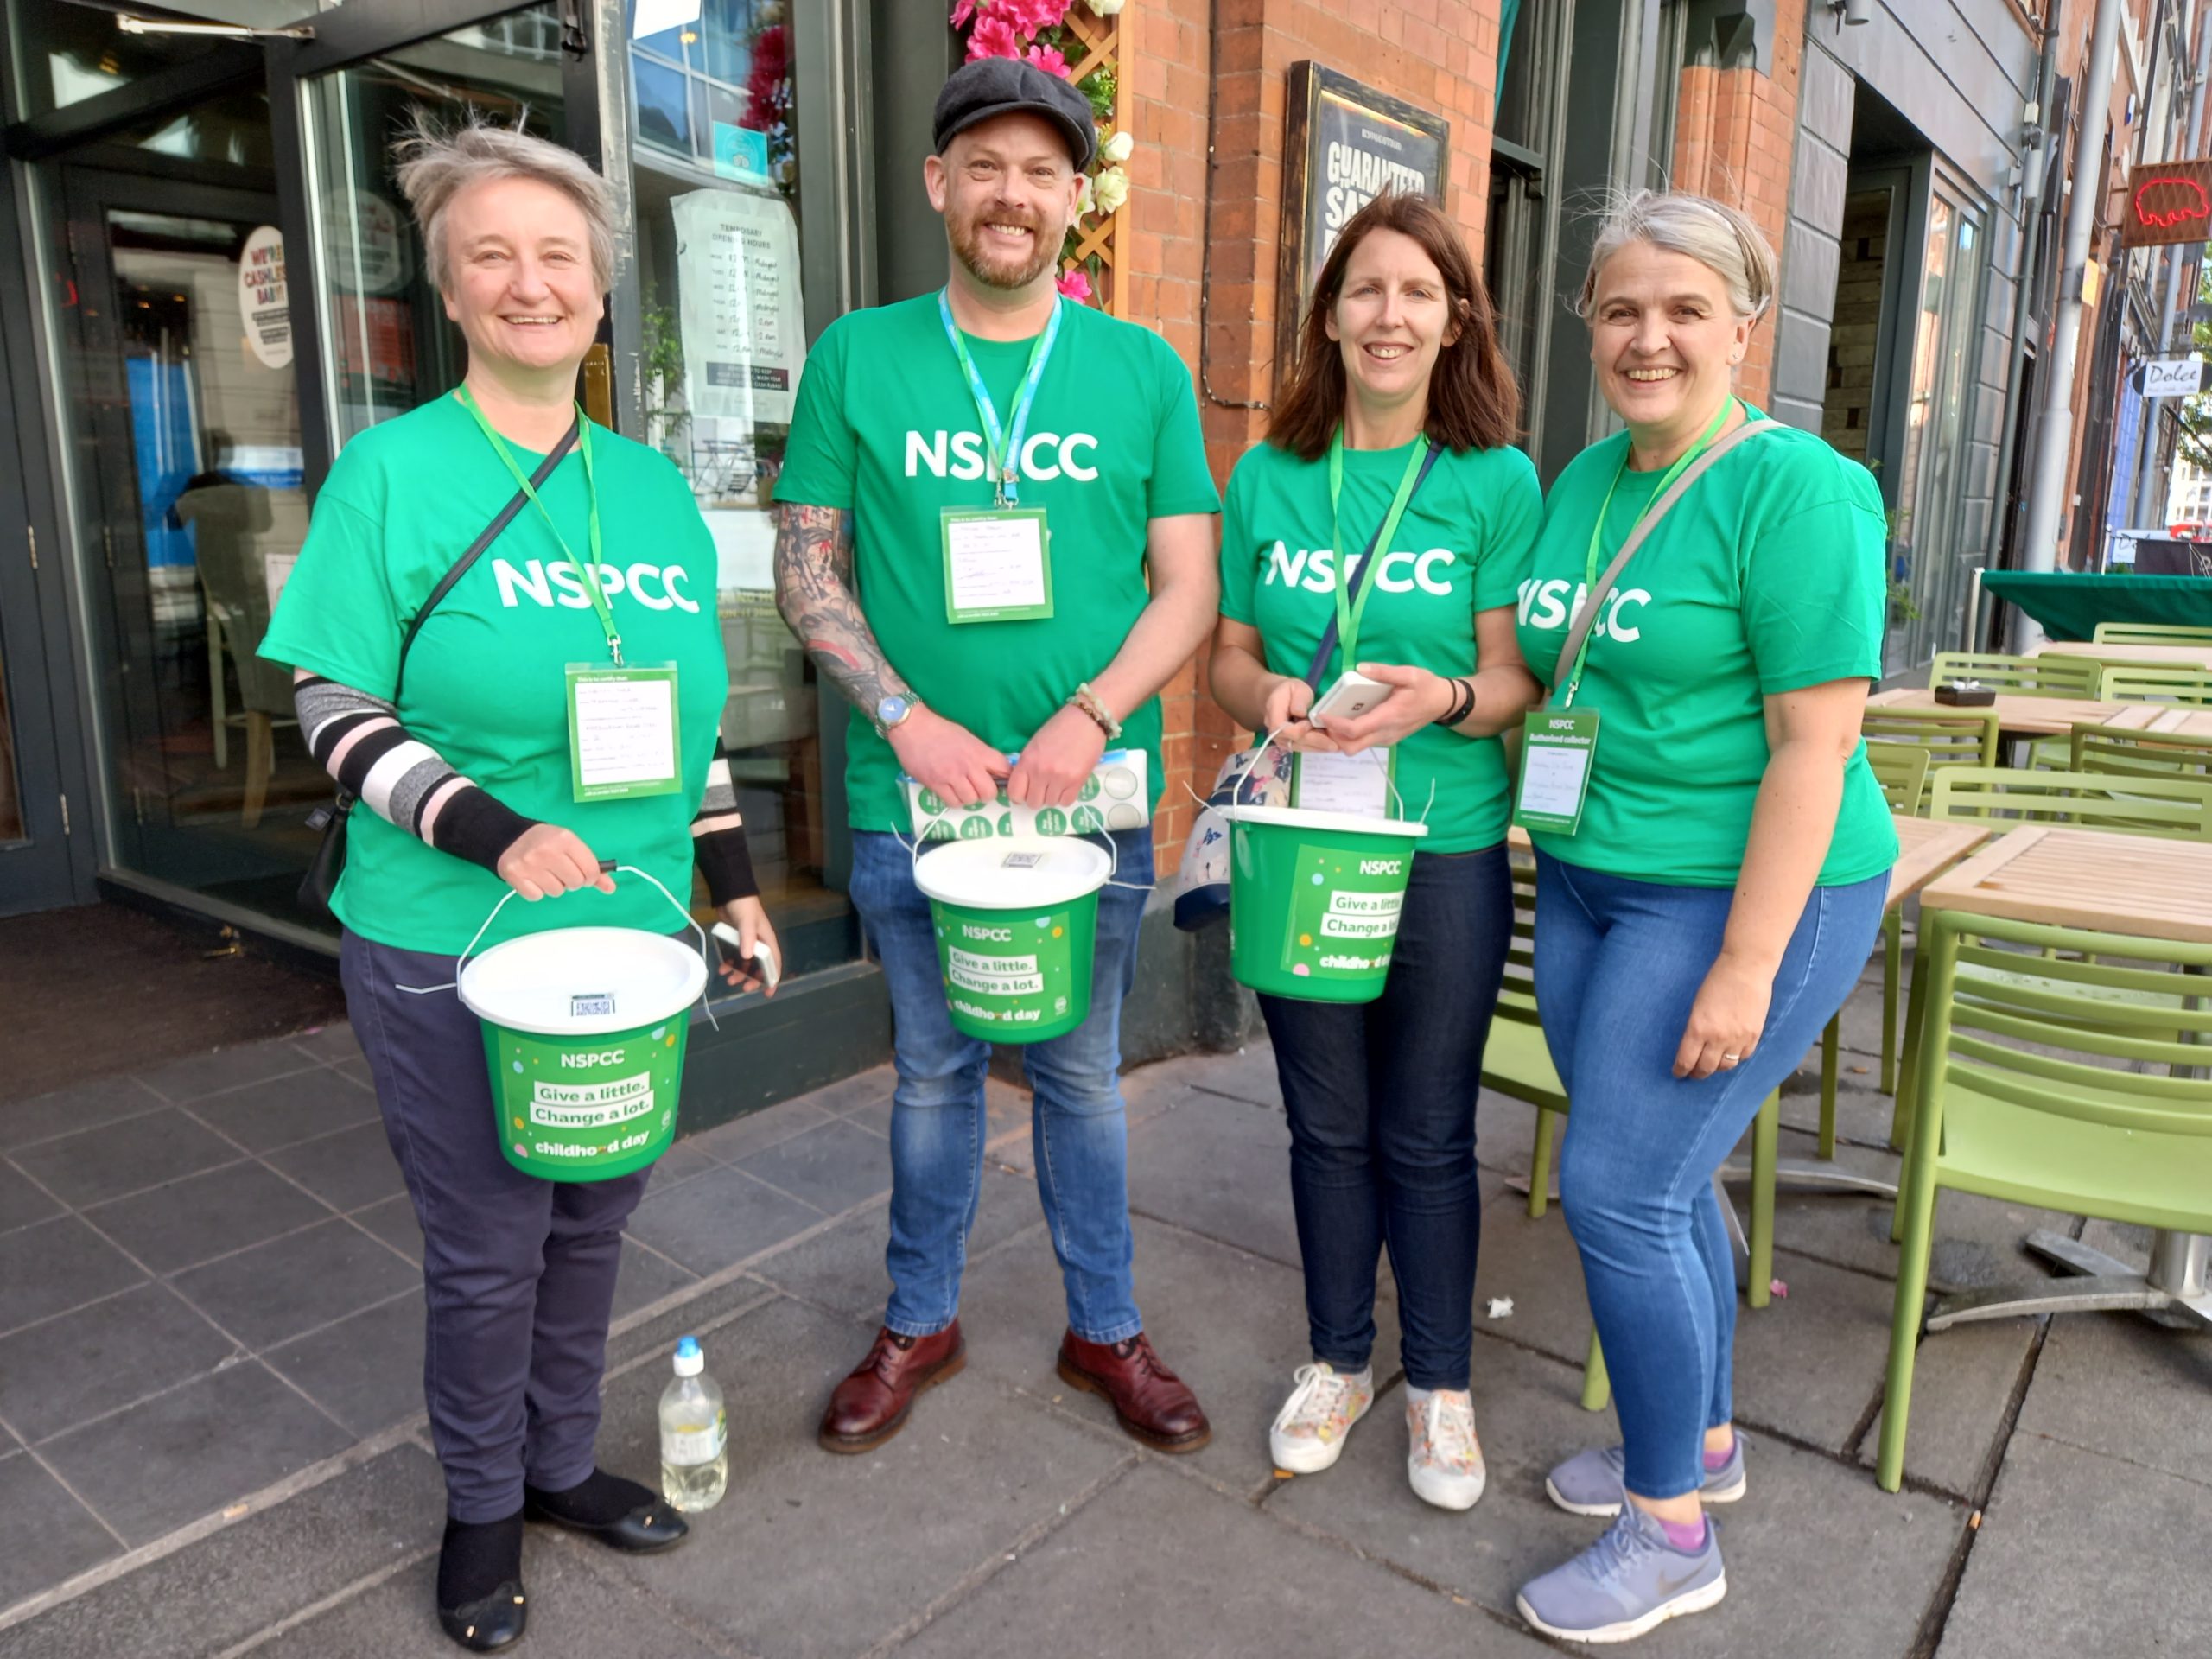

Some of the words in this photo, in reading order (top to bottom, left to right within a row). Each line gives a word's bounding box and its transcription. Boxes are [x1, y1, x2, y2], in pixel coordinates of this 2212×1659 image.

[1327, 141, 1426, 199] GUARANTEED
[747, 239, 771, 250] HOURS
[2150, 364, 2196, 384] Dolce
[491, 558, 700, 613] NSPCC
[1548, 719, 1575, 730] NSPCC
[1359, 859, 1402, 875] NSPCC
[1336, 897, 1368, 910] Give
[1370, 900, 1377, 910] a
[962, 924, 1012, 942] NSPCC
[1326, 918, 1379, 937] Change
[1382, 923, 1387, 931] a
[953, 952, 978, 969] Give
[982, 961, 989, 970] a
[994, 960, 1033, 972] little.
[952, 969, 999, 993] Change
[1001, 982, 1011, 991] a
[1014, 979, 1039, 991] lot.
[1014, 1008, 1041, 1022] day
[561, 1049, 626, 1069] NSPCC
[539, 1088, 580, 1103] Give
[584, 1091, 595, 1102] a
[600, 1080, 645, 1100] little.
[535, 1108, 605, 1127] Change
[608, 1109, 620, 1120] a
[623, 1100, 650, 1116] lot.
[621, 1130, 650, 1150] day
